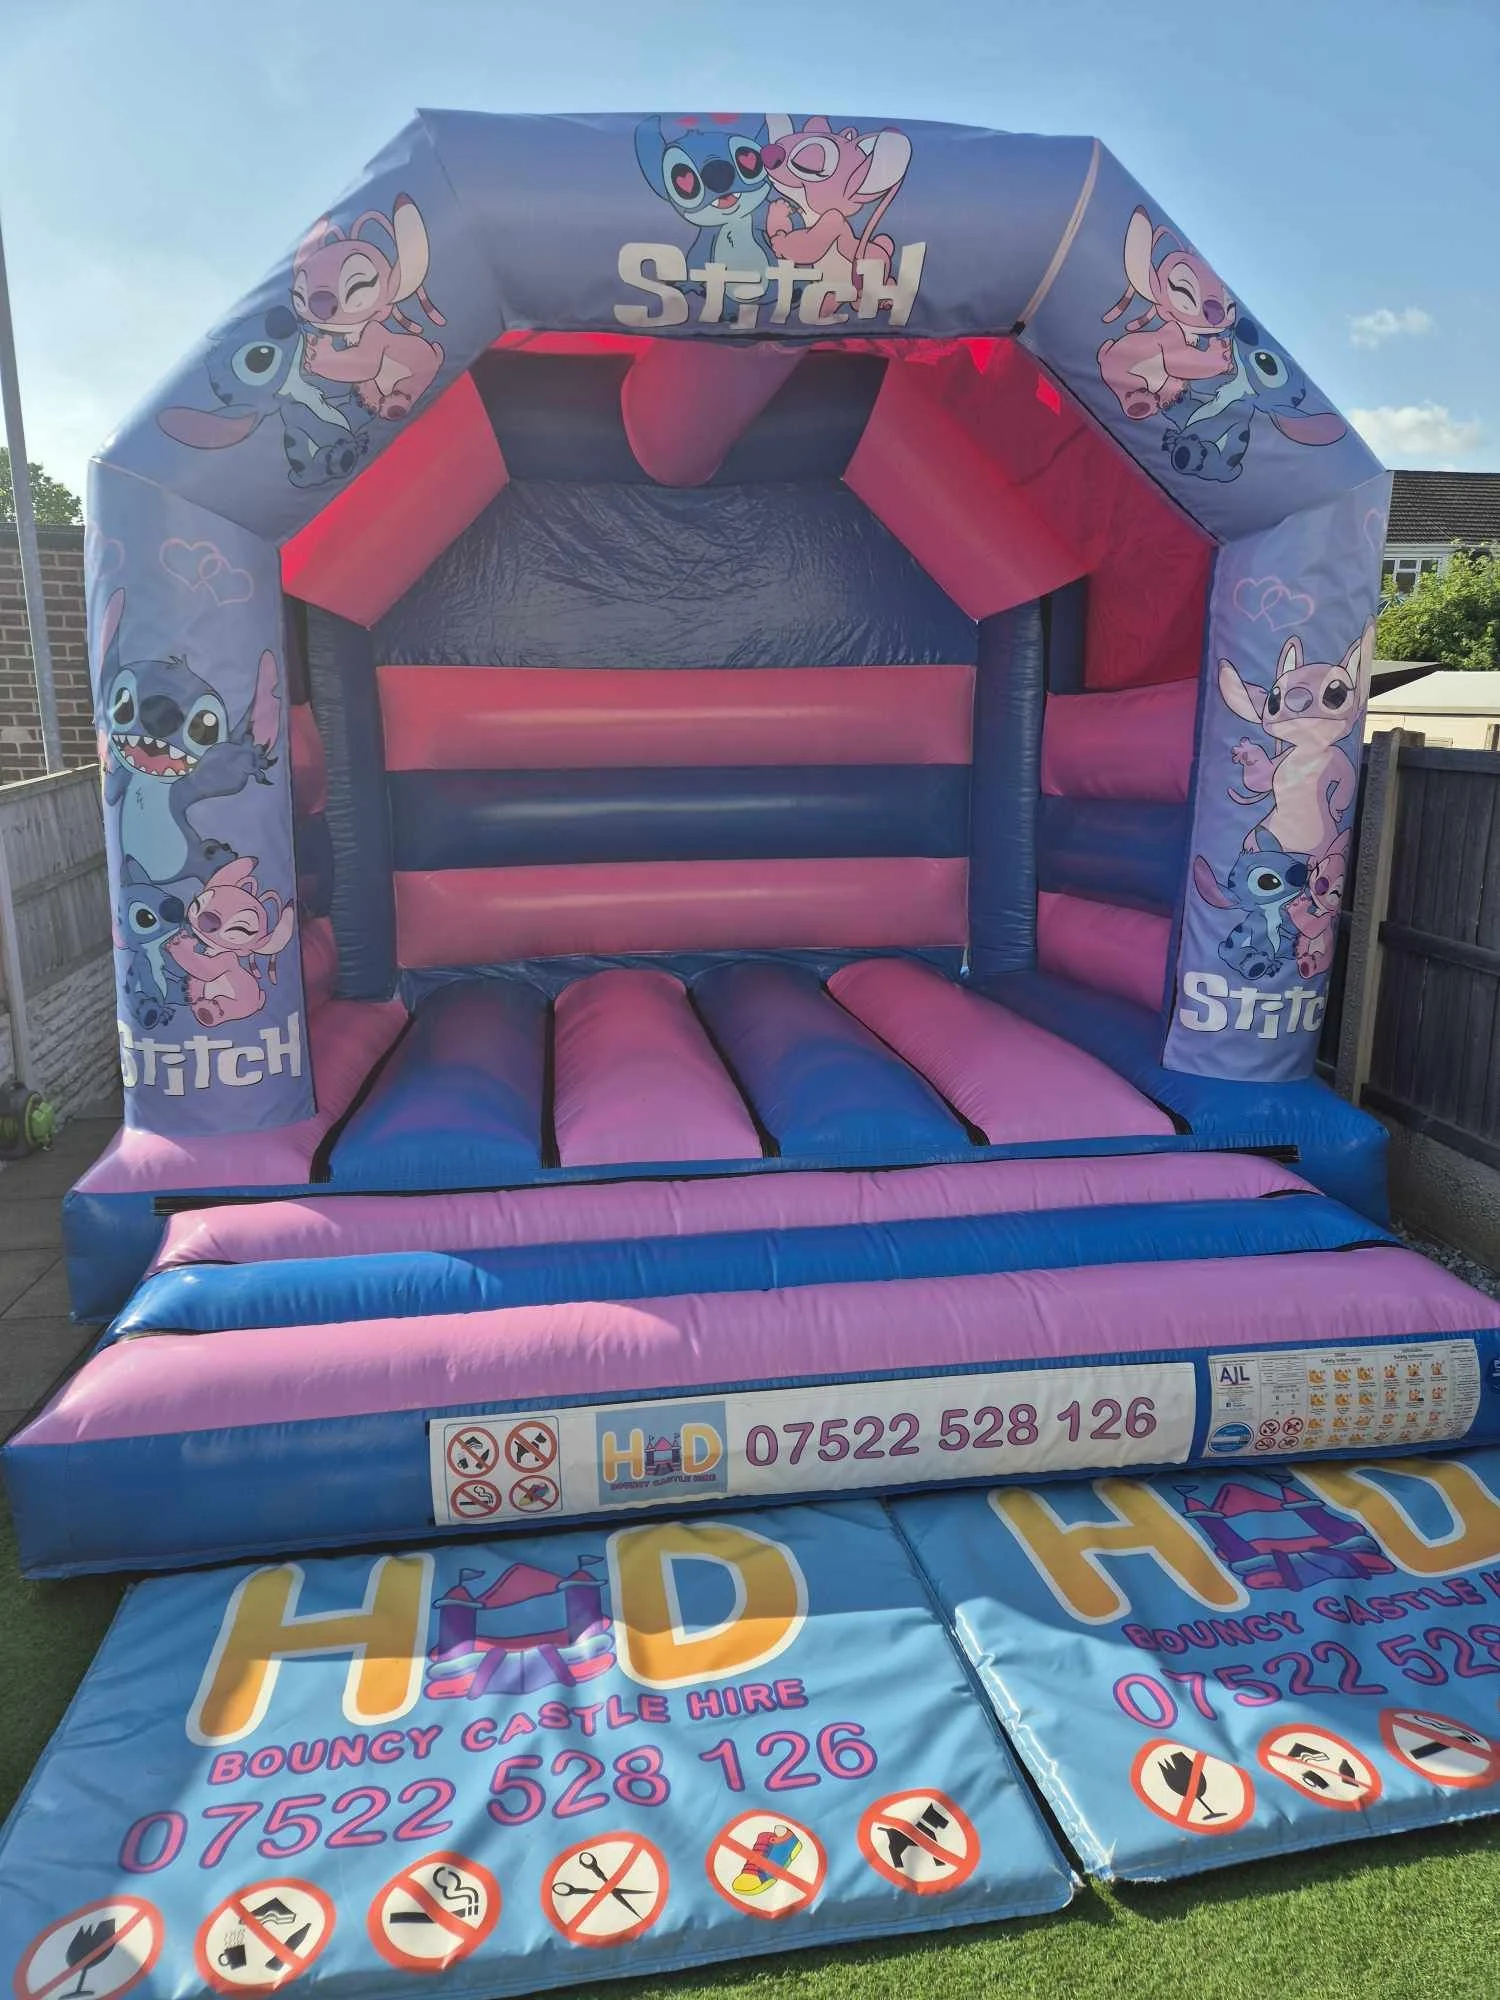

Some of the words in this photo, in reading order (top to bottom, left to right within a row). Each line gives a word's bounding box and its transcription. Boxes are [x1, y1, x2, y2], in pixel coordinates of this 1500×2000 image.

[746, 1413, 919, 1466] 07522
[938, 1404, 1038, 1450] 528
[1056, 1396, 1156, 1443] 126
[1122, 1609, 1303, 1655] BOUNCY
[1313, 1577, 1487, 1626] CASTLE
[1112, 1640, 1388, 1730] 07522
[207, 1724, 443, 1786] BOUNCY
[461, 1694, 671, 1753] CASTLE
[687, 1678, 809, 1720] HIRE
[118, 1777, 456, 1875] 07522
[486, 1744, 672, 1826] 528
[700, 1722, 878, 1793] 126
